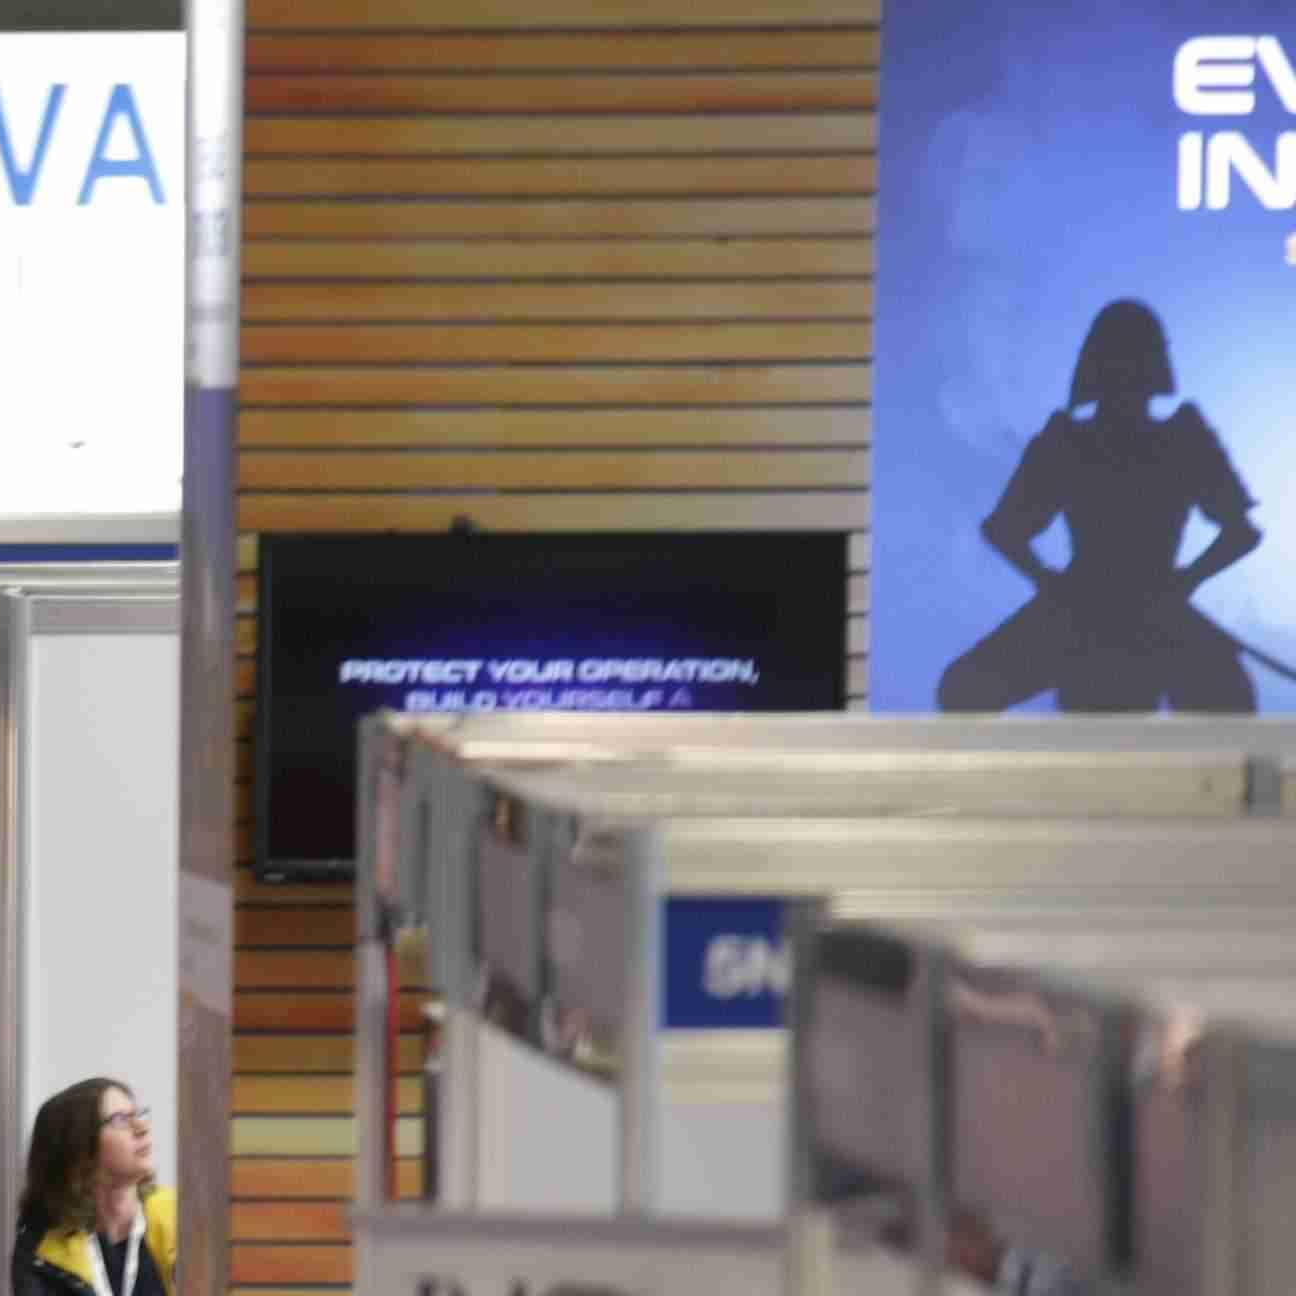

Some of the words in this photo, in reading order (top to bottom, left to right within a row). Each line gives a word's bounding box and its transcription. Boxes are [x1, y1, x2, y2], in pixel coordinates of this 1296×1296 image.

[339, 658, 483, 684] PROTECT
[488, 658, 573, 683] YOUR
[577, 658, 760, 687] OPERATION,
[499, 690, 664, 710] YOURSELF
